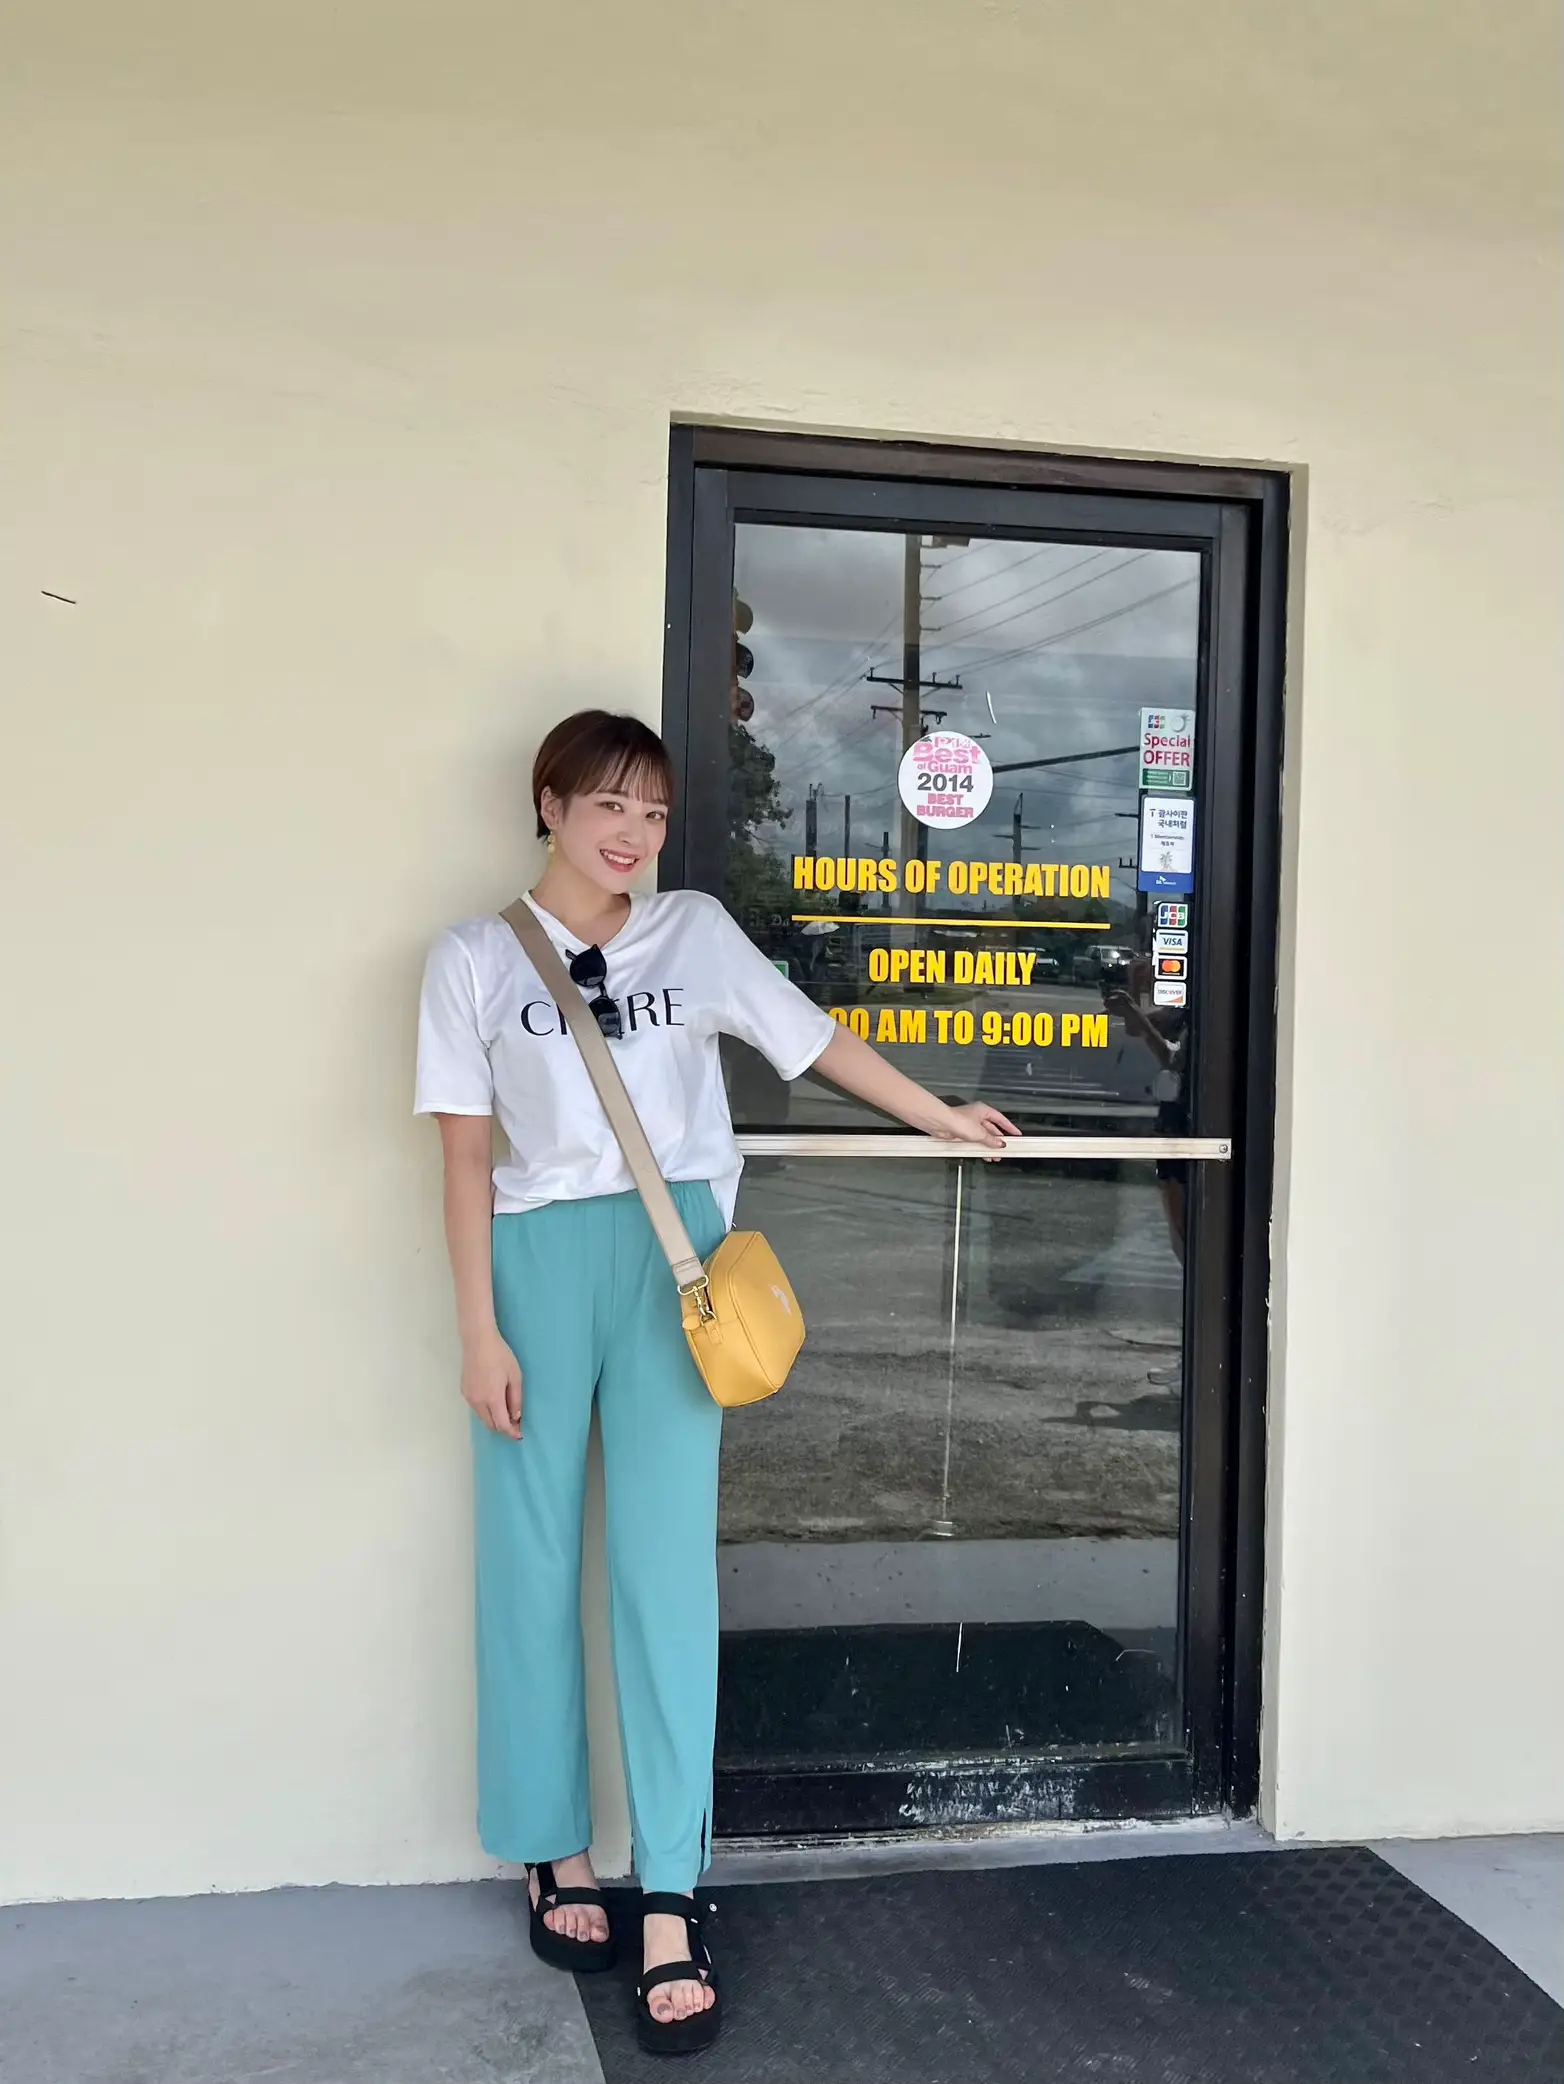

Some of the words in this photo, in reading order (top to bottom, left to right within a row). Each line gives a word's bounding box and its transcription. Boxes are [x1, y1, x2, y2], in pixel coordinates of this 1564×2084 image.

[1144, 733, 1191, 748] Special
[913, 742, 981, 764] Best
[1143, 750, 1190, 767] OFFER
[928, 761, 972, 774] Guam
[917, 773, 974, 792] 2014
[928, 793, 964, 805] BEST
[916, 805, 974, 818] BURGER
[792, 856, 897, 893] HOURS
[904, 859, 942, 894] OF
[947, 860, 1111, 898] OPERATION
[1163, 938, 1182, 946] VISA
[868, 948, 946, 985] OPEN
[954, 950, 1037, 986] DAILY
[520, 988, 685, 1036] CRE
[876, 1009, 926, 1044] AM
[933, 1010, 974, 1045] TO
[981, 1011, 1053, 1046] 9:00
[1061, 1014, 1109, 1048] PM
